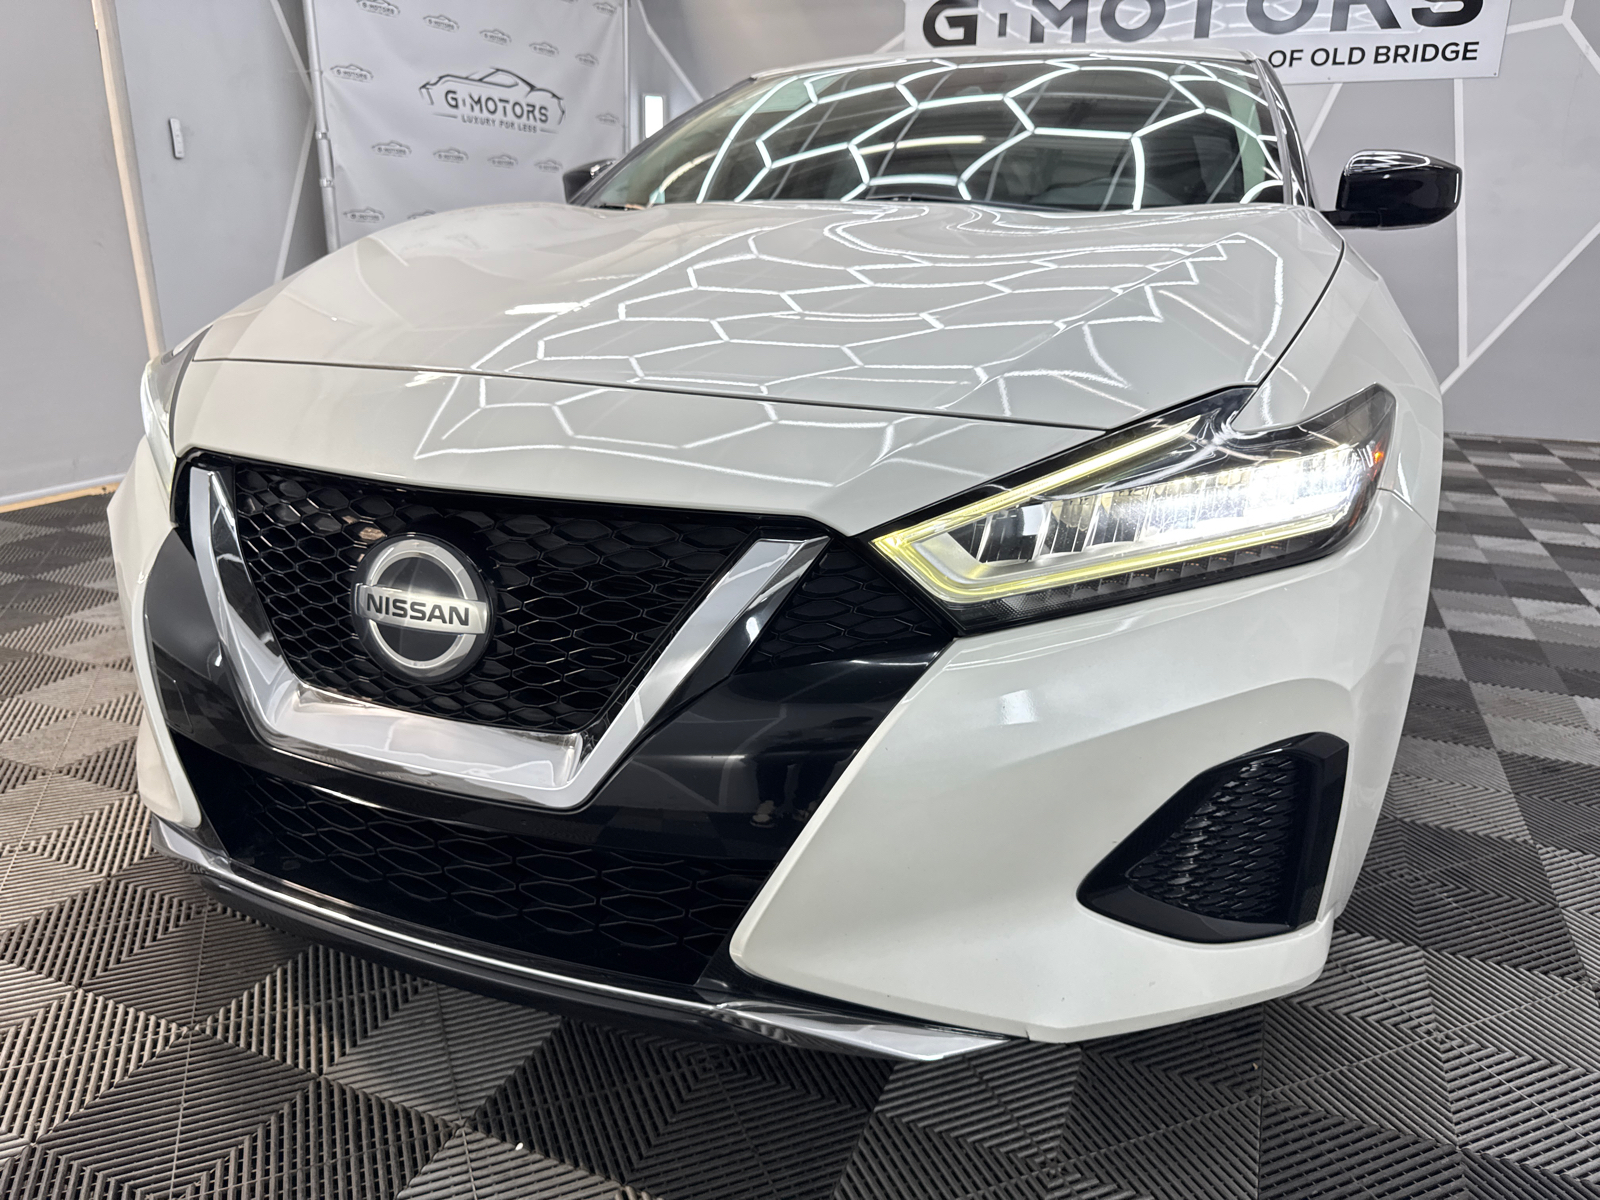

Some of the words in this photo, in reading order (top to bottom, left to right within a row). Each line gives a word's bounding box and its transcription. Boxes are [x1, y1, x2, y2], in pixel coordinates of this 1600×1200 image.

[1268, 49, 1304, 68] OF
[1310, 46, 1366, 66] OLD
[1373, 41, 1480, 65] BRIDGE
[461, 114, 496, 127] LUXURY
[499, 120, 516, 130] FOR
[517, 123, 538, 133] LESS
[366, 593, 470, 626] NISSAN
